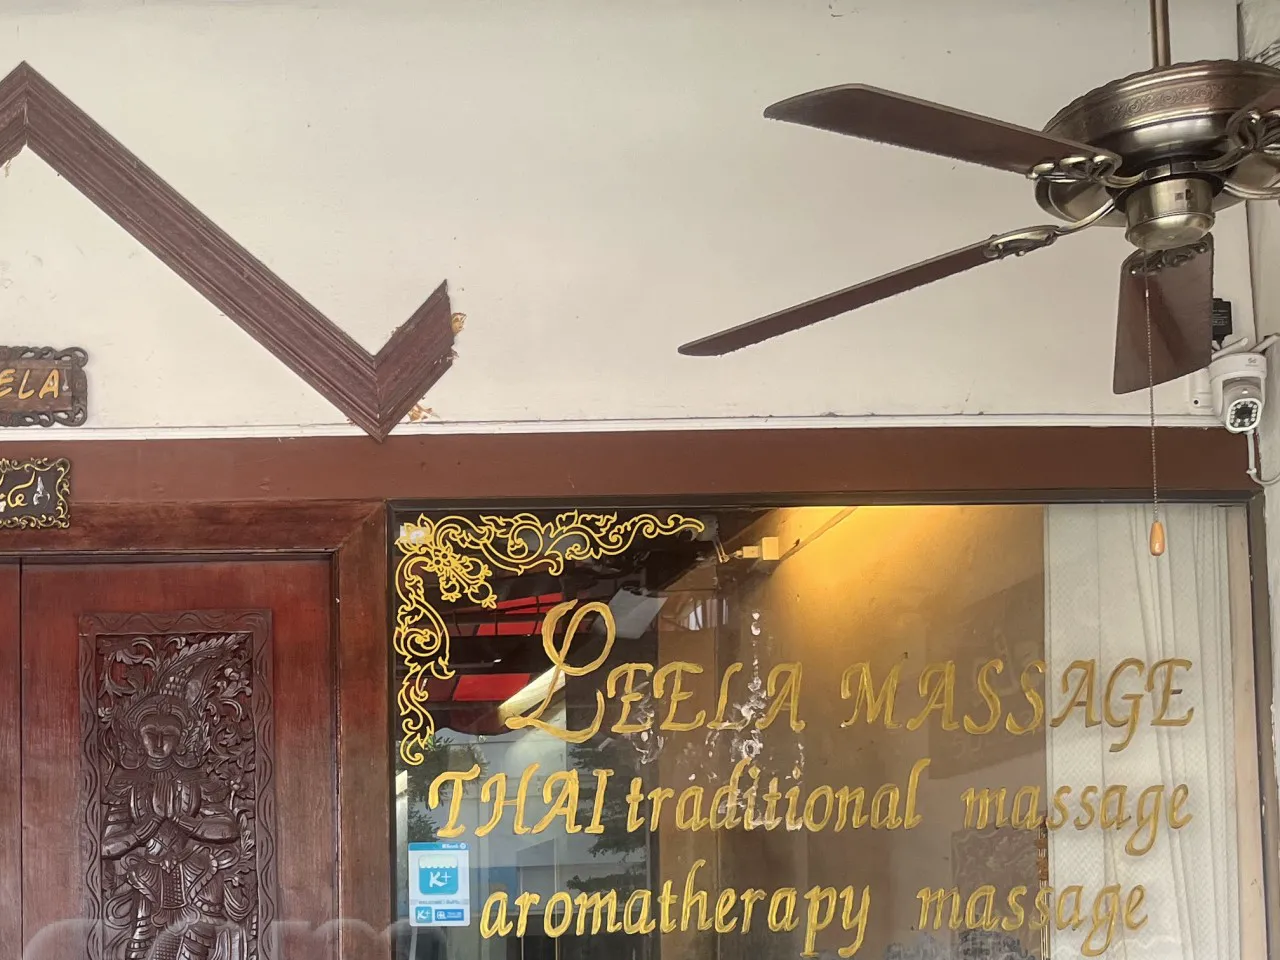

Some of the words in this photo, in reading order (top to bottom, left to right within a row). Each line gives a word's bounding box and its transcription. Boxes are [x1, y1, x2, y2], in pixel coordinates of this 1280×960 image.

[504, 599, 807, 743] LEELA
[840, 657, 1195, 753] MASSAGE
[428, 763, 613, 838] THAI
[625, 758, 922, 836] traditional
[959, 782, 1195, 856] massage
[479, 859, 871, 958] aromatherapy
[916, 882, 1150, 958] massage
